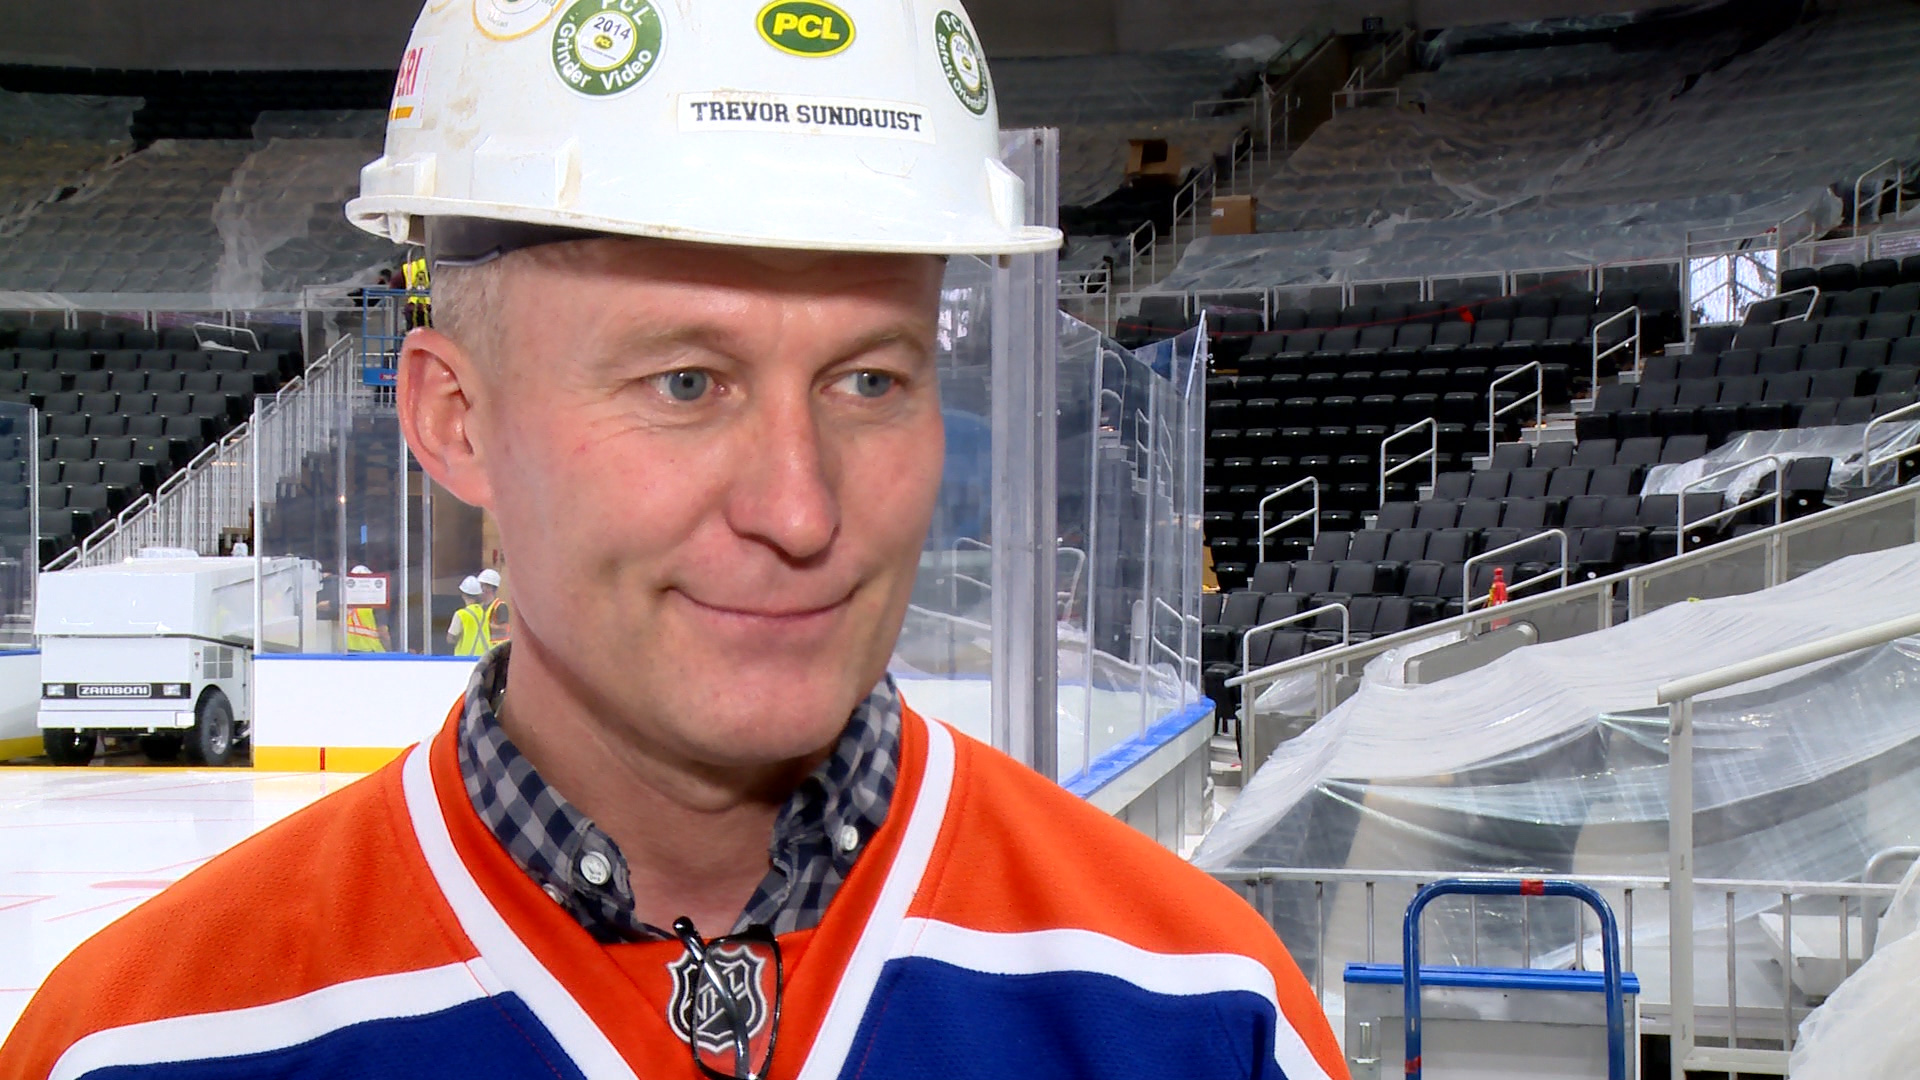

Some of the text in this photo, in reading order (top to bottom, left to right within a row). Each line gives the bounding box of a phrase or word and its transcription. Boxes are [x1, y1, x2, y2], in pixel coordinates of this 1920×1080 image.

[593, 16, 632, 40] 2014
[772, 12, 841, 41] PCL
[941, 14, 969, 40] PCL
[557, 22, 652, 91] Grinder Video
[938, 33, 955, 78] Safety
[690, 101, 922, 132] TREVOR SUNDQUIST
[81, 686, 148, 695] ZAMBONI
